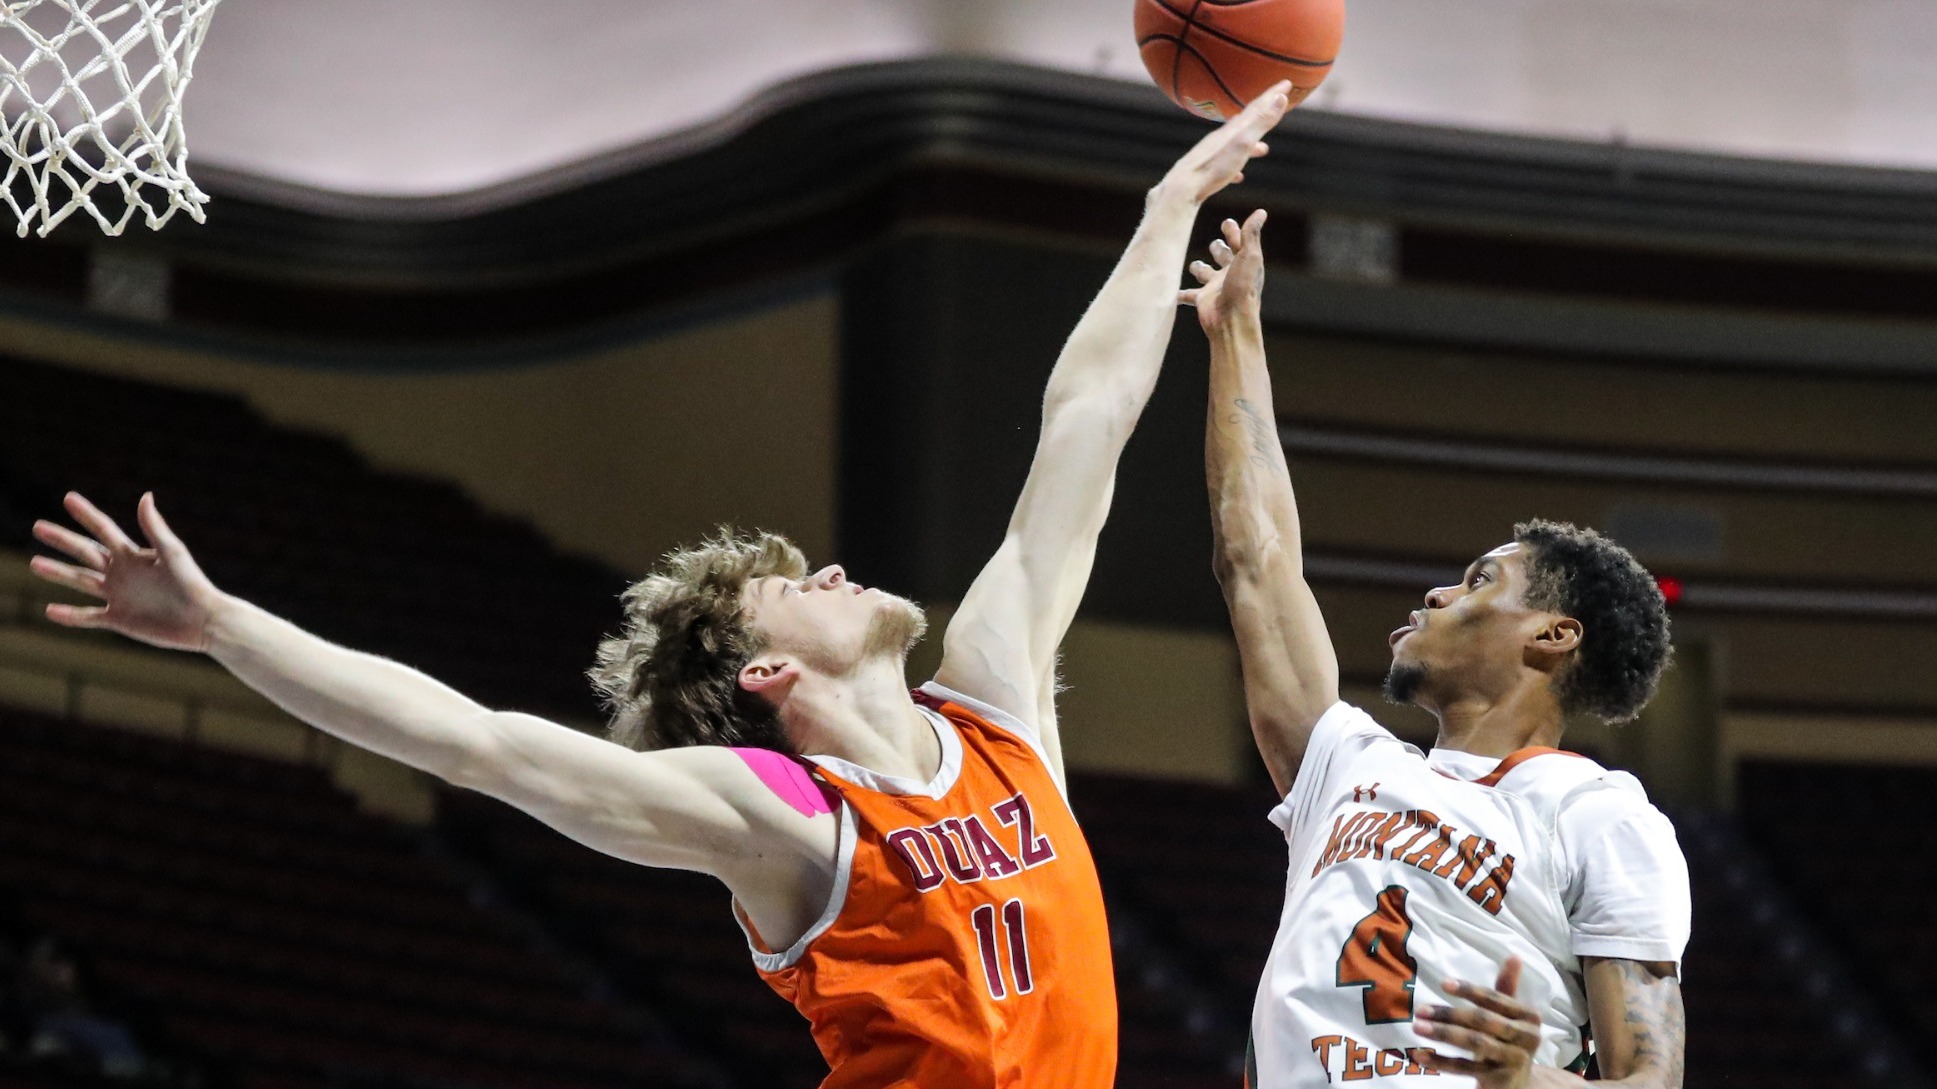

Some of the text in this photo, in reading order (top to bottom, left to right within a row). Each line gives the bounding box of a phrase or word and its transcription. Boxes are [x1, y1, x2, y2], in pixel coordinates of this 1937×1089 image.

[887, 793, 1057, 893] OUAZ
[1311, 809, 1515, 916] MONTANA
[971, 898, 1034, 1001] 11
[1336, 885, 1418, 1025] 4
